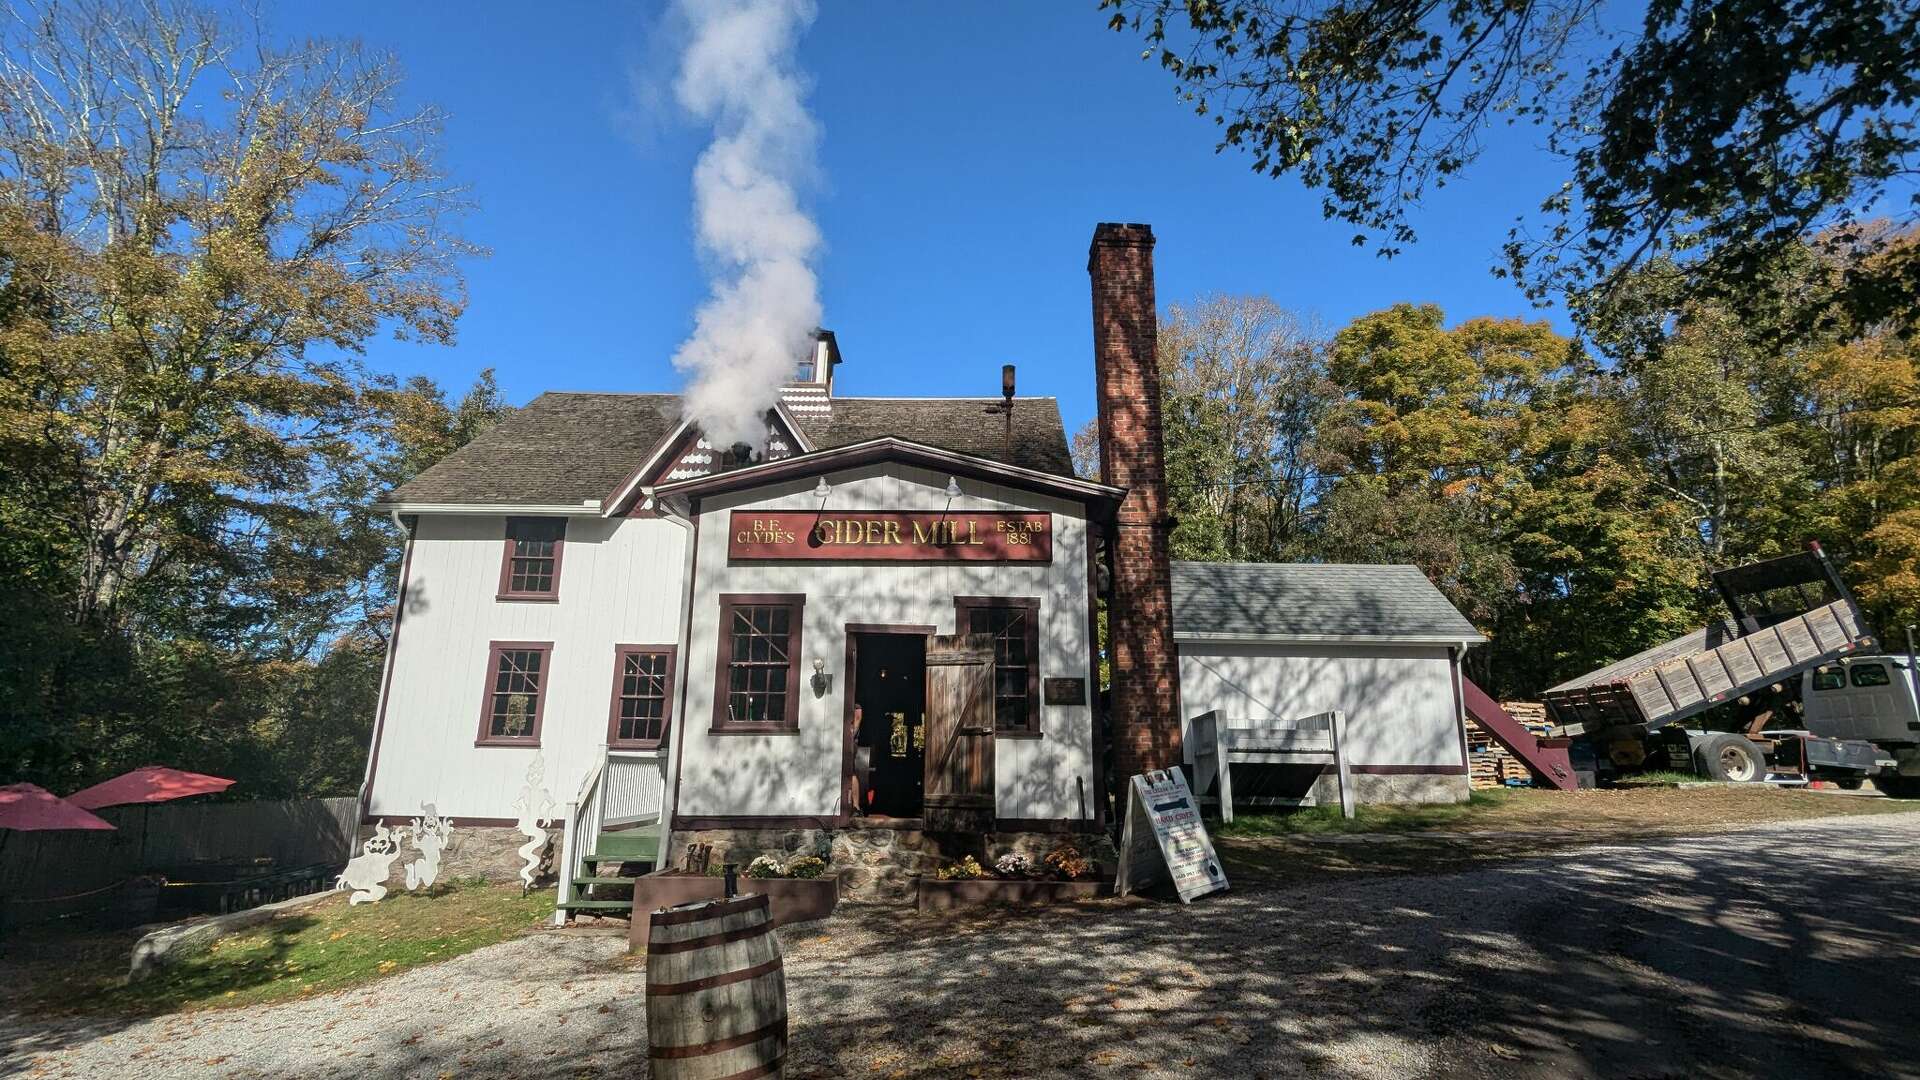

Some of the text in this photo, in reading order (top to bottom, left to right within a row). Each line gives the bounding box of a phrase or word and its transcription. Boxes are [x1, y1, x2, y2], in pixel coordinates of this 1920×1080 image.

[815, 520, 984, 545] CIDER MILL
[997, 521, 1043, 533] ESTAB
[737, 531, 795, 544] CLYDE'S
